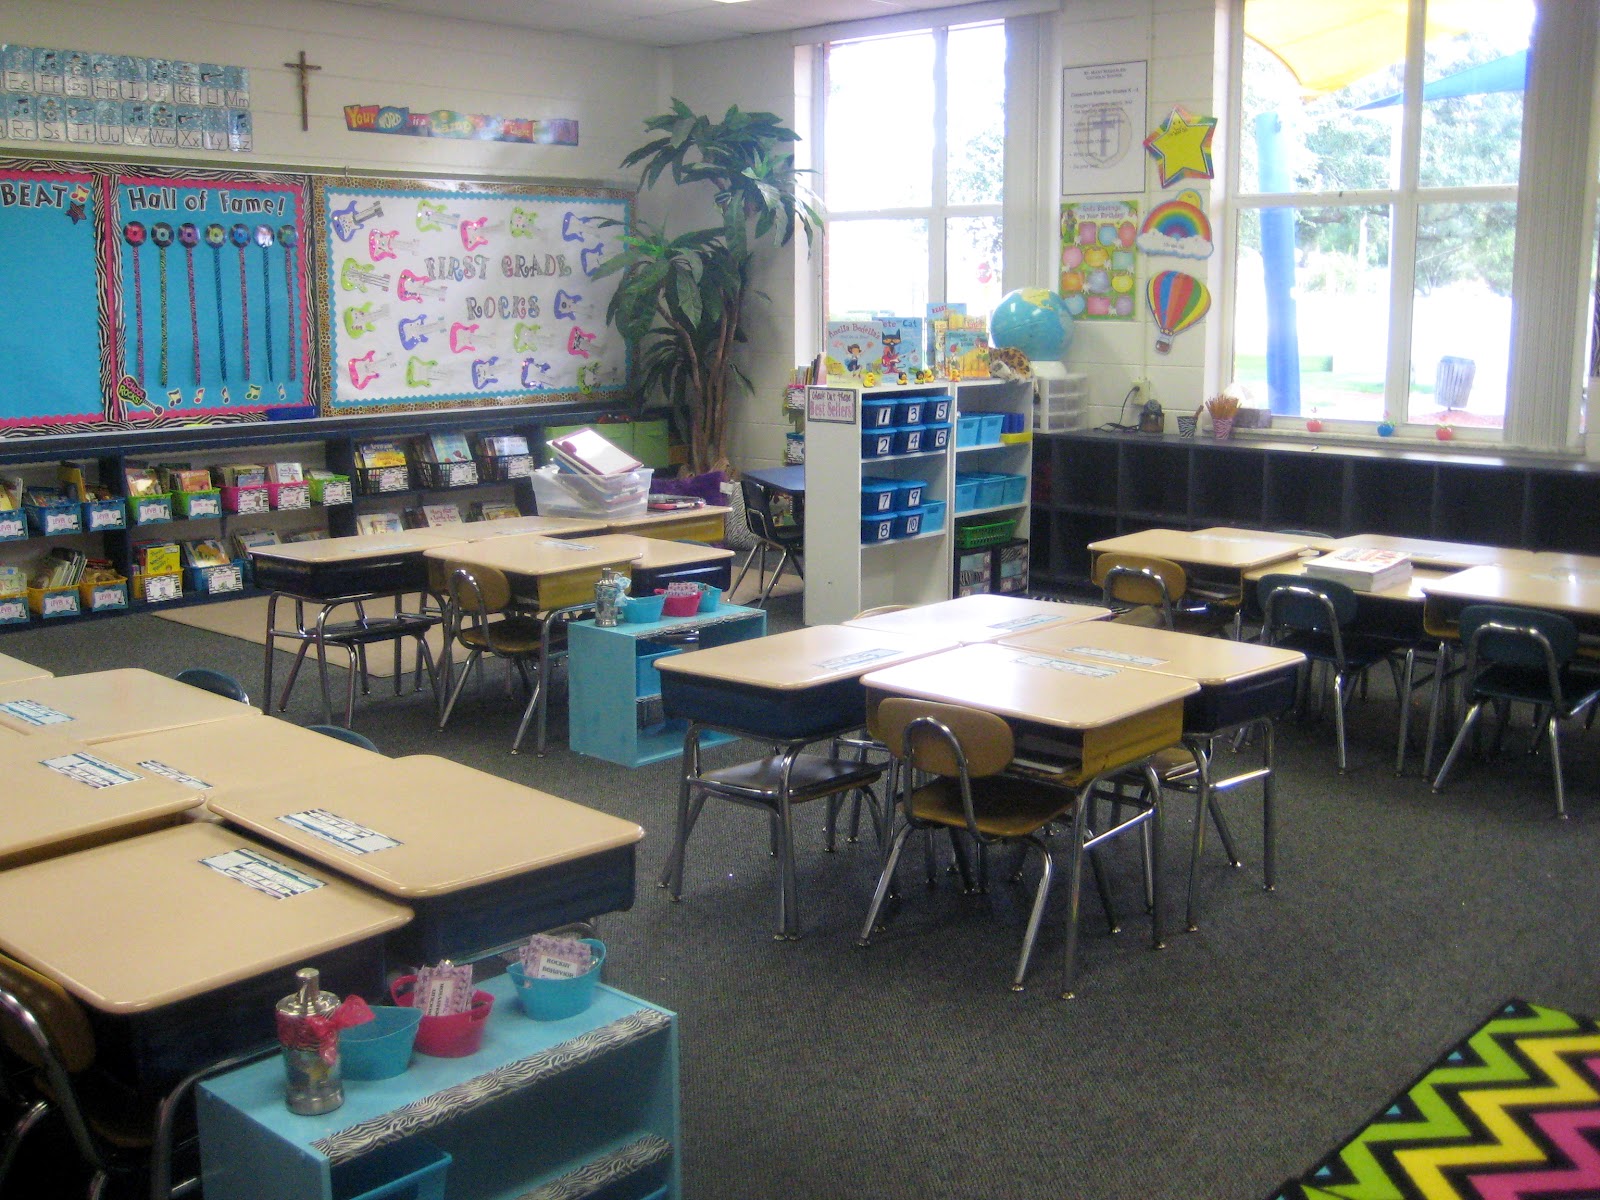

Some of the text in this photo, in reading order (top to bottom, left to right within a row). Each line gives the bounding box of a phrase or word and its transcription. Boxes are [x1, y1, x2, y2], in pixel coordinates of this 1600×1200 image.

[345, 106, 376, 128] Your
[12, 119, 33, 139] Rr
[43, 121, 60, 140] Ss
[99, 125, 120, 143] Uu
[151, 129, 177, 145] Ww
[180, 129, 200, 147] Xx
[0, 182, 68, 208] BEAT
[128, 187, 285, 217] Hall of Fame!
[424, 254, 572, 282] FIRST GRADE
[465, 295, 541, 321] ROCKS
[902, 319, 917, 328] Cat
[910, 407, 917, 421] 3
[937, 404, 945, 418] 5
[879, 438, 888, 453] 2
[910, 434, 918, 448] 4
[937, 431, 945, 445] 6
[881, 494, 889, 509] 7
[910, 491, 919, 506] 9
[880, 523, 889, 537] 8
[908, 517, 918, 532] 10
